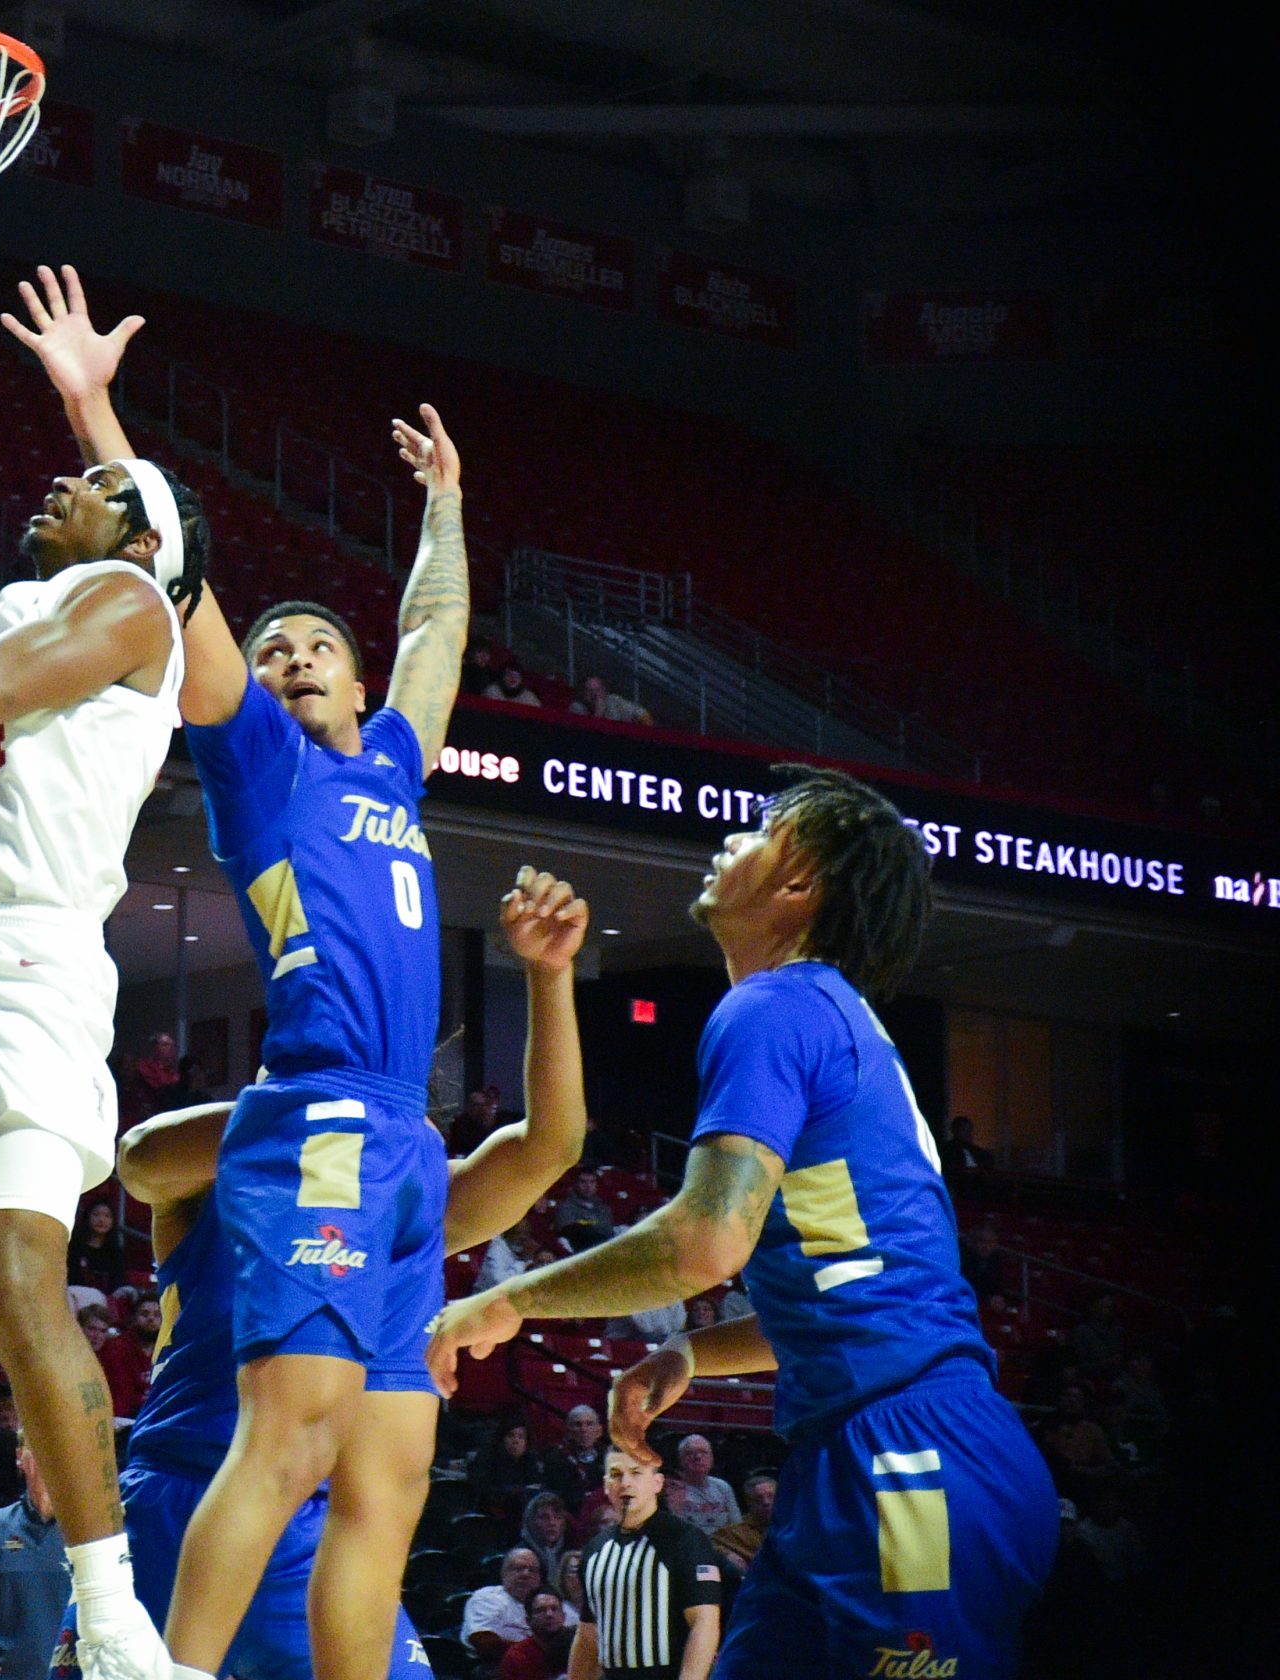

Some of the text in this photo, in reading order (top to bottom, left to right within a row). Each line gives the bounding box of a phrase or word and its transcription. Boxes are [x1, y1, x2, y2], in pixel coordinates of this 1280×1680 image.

[157, 161, 250, 202] NORMAN
[434, 746, 519, 783] ouse
[543, 758, 683, 813] CENTER
[974, 830, 1186, 895] STEAKHOUSE
[391, 860, 423, 930] 0
[285, 1238, 368, 1269] Tulsa
[867, 1647, 958, 1679] Tulsa
